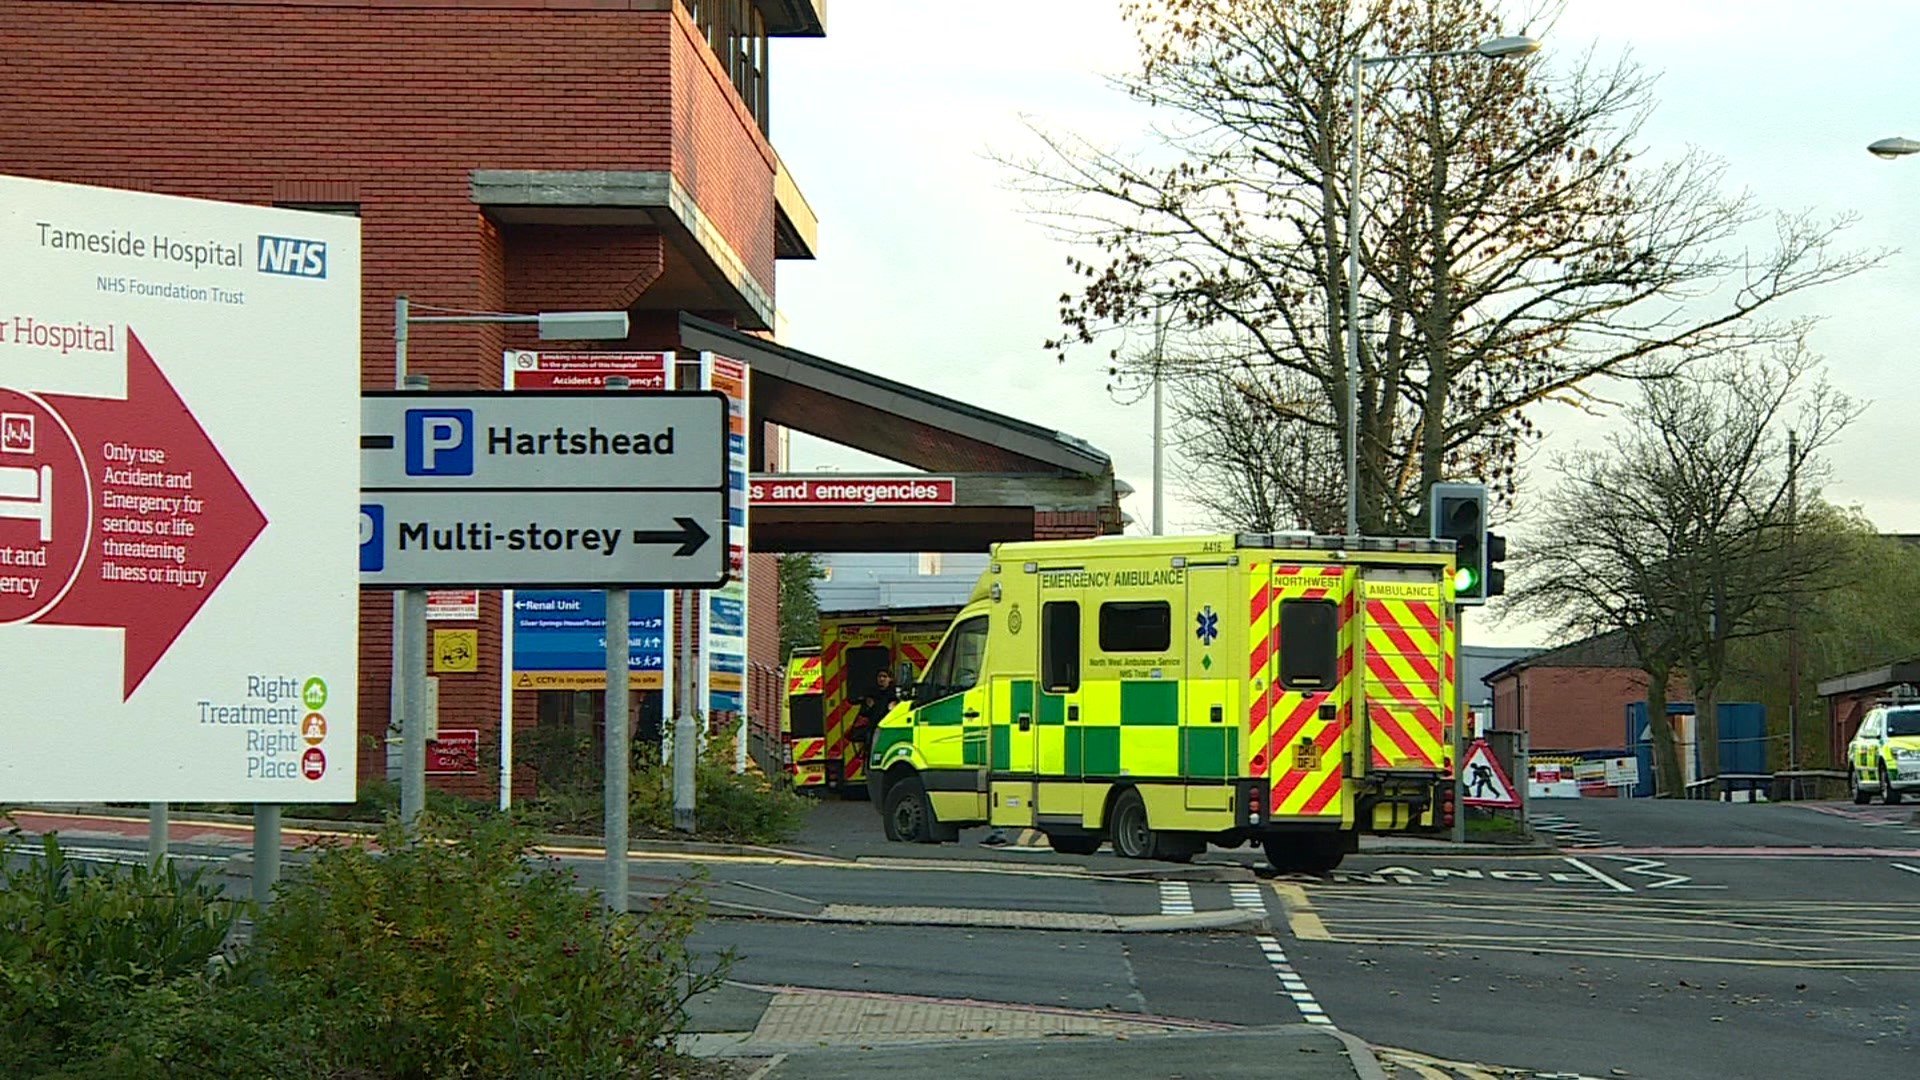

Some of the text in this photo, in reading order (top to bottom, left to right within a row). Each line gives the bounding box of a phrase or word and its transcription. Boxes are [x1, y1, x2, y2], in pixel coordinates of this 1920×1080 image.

[36, 222, 244, 270] Tameside Hospital
[258, 237, 326, 277] NHS
[96, 276, 245, 305] NHS Foundation Trust
[14, 317, 115, 354] Hospital
[553, 376, 592, 385] Accident
[594, 376, 602, 385] &
[103, 443, 165, 464] Only use
[422, 416, 675, 469] P Hartshead
[103, 467, 192, 489] Accident and
[103, 491, 203, 516] Emergency for
[772, 481, 808, 499] and
[816, 481, 939, 503] emergencies
[102, 514, 195, 536] serious or life
[399, 521, 622, 556] Multi-storey
[15, 546, 47, 567] and
[103, 538, 186, 564] threatening
[102, 562, 207, 588] illness or injury
[1042, 569, 1184, 589] EMERGENCY AMBULANCE
[1369, 585, 1435, 597] AMBULANCE
[526, 600, 581, 611] Renal Unit
[1158, 657, 1180, 666] Service
[247, 675, 298, 703] Right
[536, 676, 557, 684] CCTV
[198, 702, 298, 725] Treatment
[246, 729, 298, 757] Right
[246, 756, 297, 780] Place
